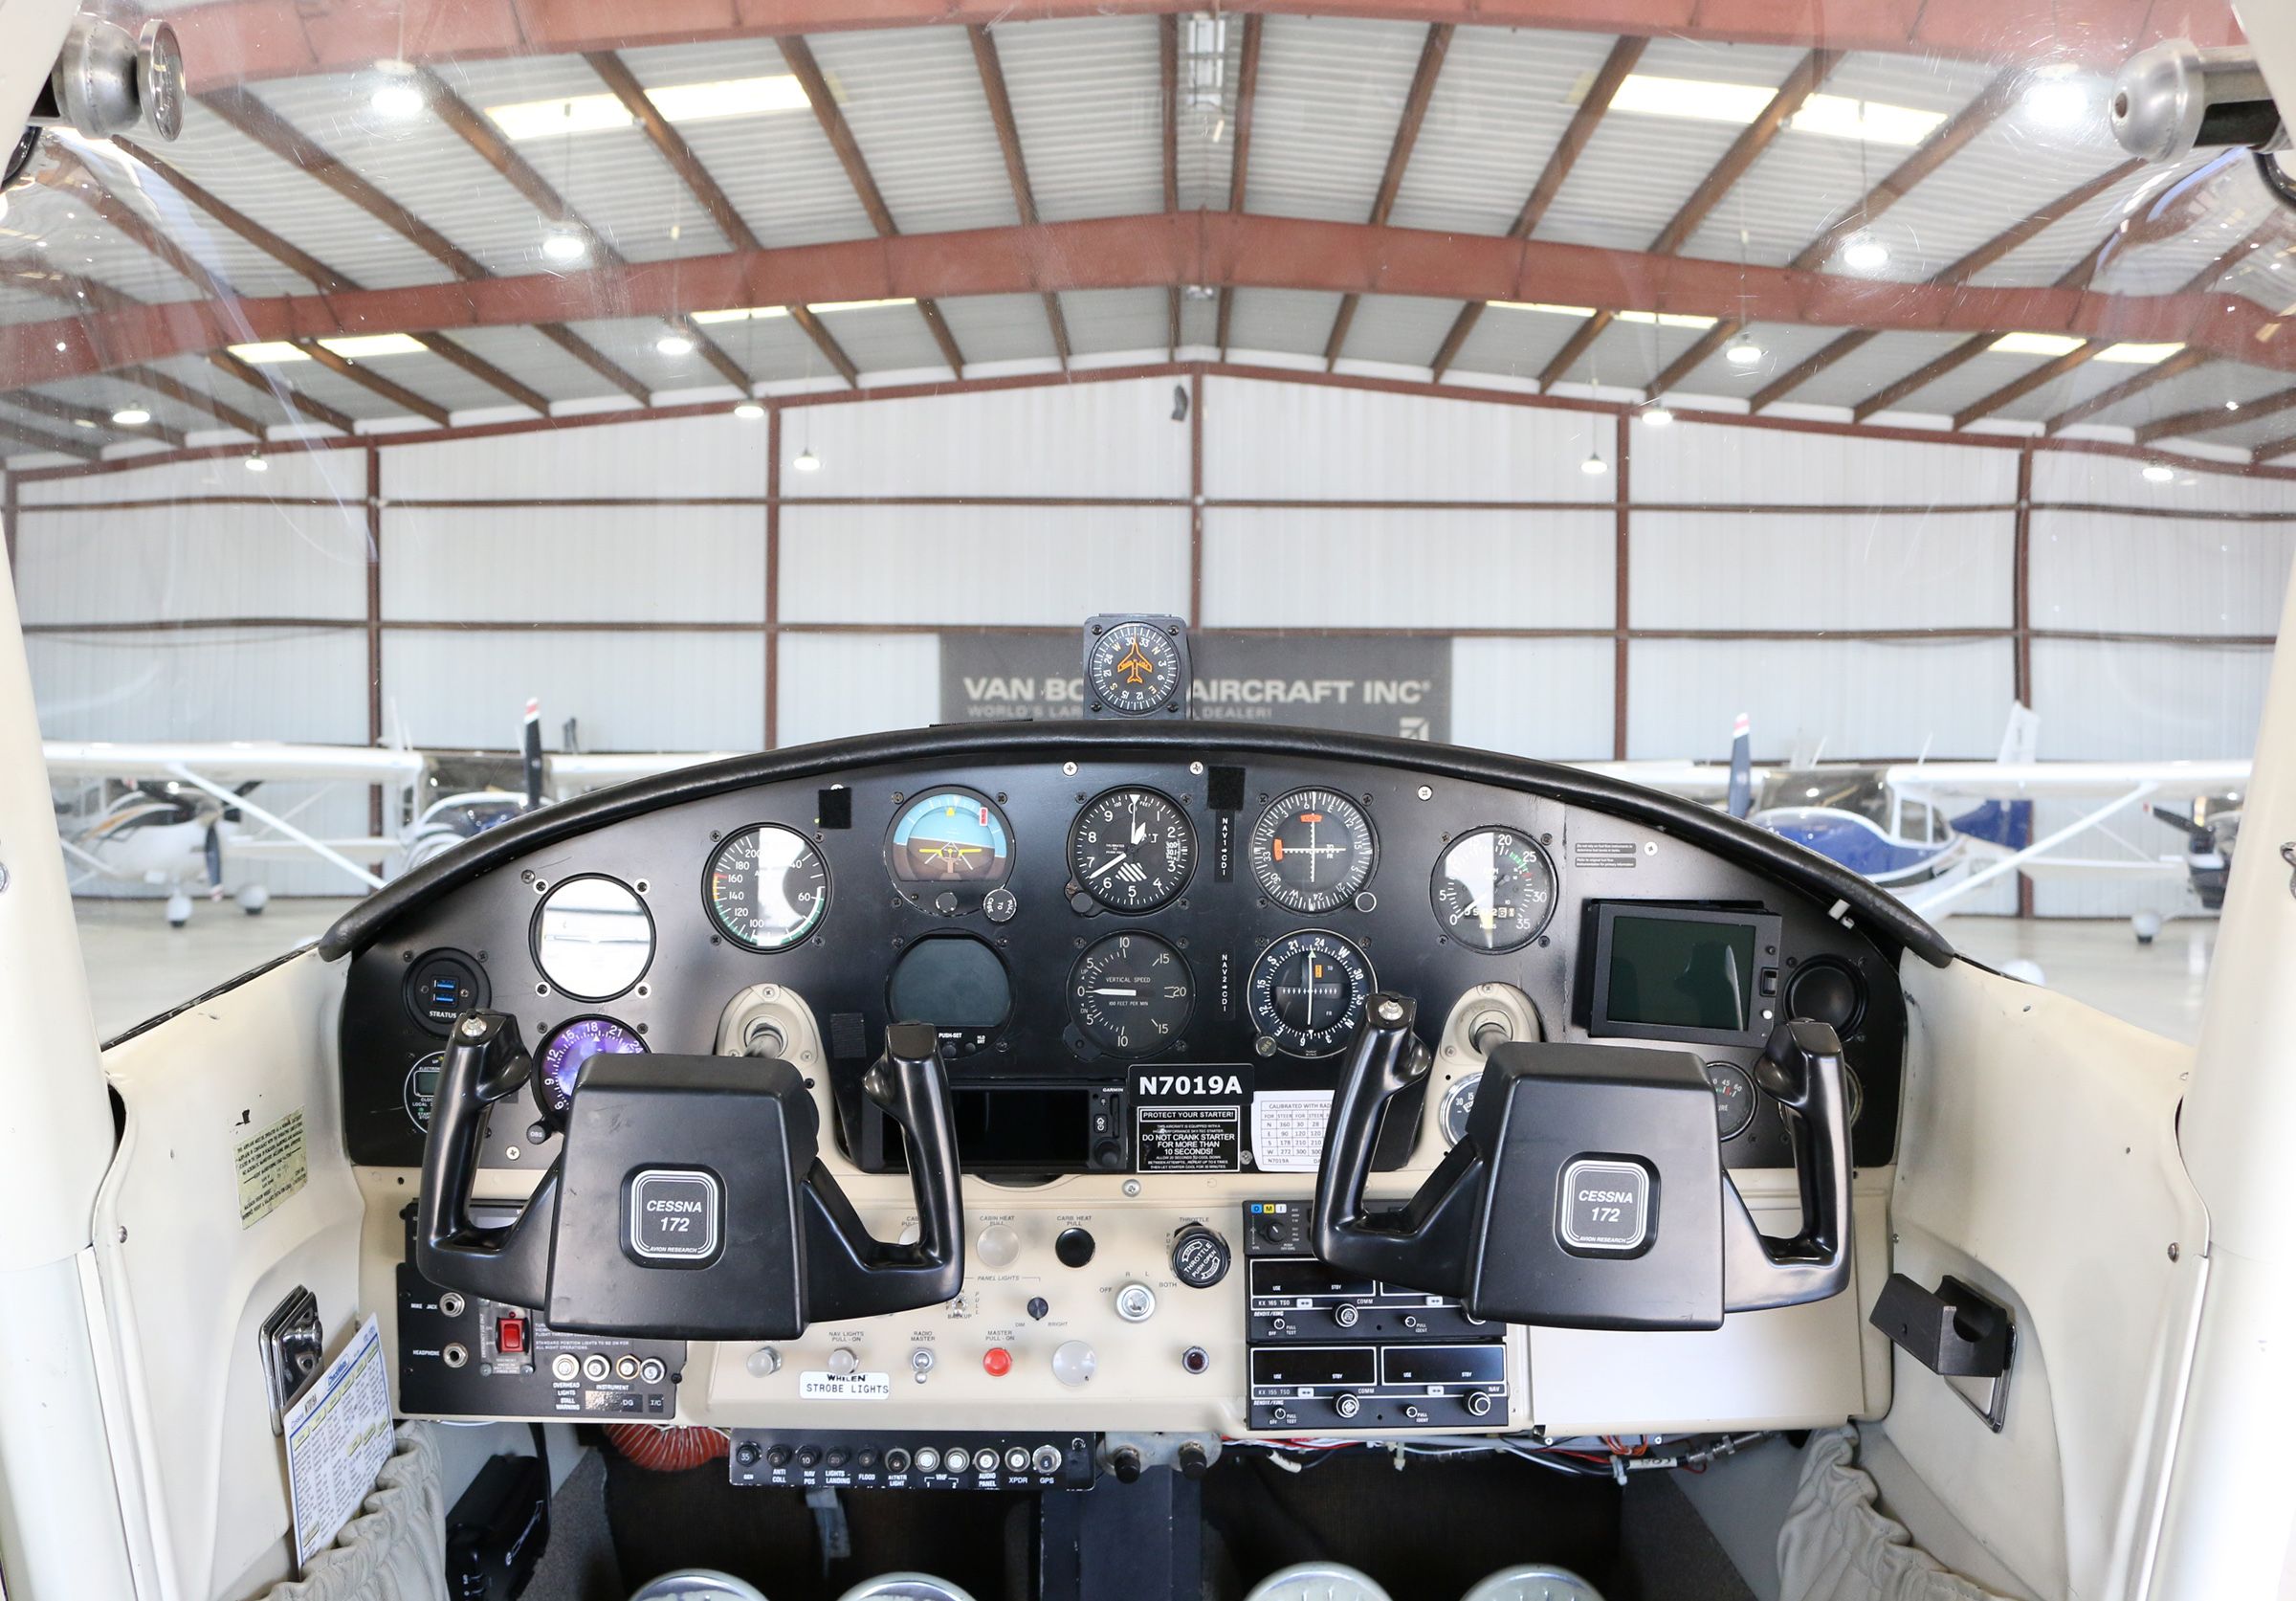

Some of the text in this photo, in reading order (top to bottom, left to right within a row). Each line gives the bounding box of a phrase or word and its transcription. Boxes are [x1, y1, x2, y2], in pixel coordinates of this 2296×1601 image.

[1125, 637, 1135, 646] 30
[1139, 637, 1150, 647] 33
[962, 678, 1034, 701] VAN
[1186, 678, 1355, 703] AIRCRAFT
[1104, 811, 1113, 822] 9
[1088, 832, 1096, 843] 8
[1167, 826, 1176, 838] 2
[1498, 834, 1512, 846] 20
[1087, 856, 1094, 868] 7
[1523, 852, 1537, 863] 25
[736, 861, 749, 870] 180
[1167, 861, 1176, 872] 3
[1103, 878, 1112, 888] 6
[1153, 878, 1161, 888] 4
[1128, 886, 1137, 897] 5
[1439, 890, 1446, 901] 5
[1533, 891, 1547, 902] 30
[1516, 919, 1531, 929] 35
[1119, 937, 1130, 947] 10
[1289, 940, 1299, 950] 21
[1314, 938, 1325, 946] 24
[1338, 945, 1350, 958] W
[1087, 958, 1093, 968] 5
[1159, 954, 1169, 964] 15
[1354, 968, 1364, 980] 30
[1257, 979, 1266, 989] 15
[1078, 986, 1084, 996] 0
[1173, 987, 1186, 996] 20
[430, 1011, 456, 1019] STRATUS
[1259, 1006, 1269, 1016] 12
[1087, 1014, 1093, 1025] 5
[585, 1022, 598, 1032] 18
[609, 1025, 622, 1037] 21
[1159, 1024, 1168, 1034] 15
[562, 1030, 574, 1042] 15
[1117, 1035, 1128, 1046] 10
[629, 1040, 643, 1053] 24
[547, 1050, 559, 1061] 12
[1139, 1076, 1243, 1095] N7019A
[1578, 1190, 1632, 1203] CESSNA
[647, 1200, 701, 1212] CESSNA
[1592, 1207, 1620, 1222] 172
[661, 1217, 690, 1232] 172
[1184, 1242, 1212, 1273] THROTTLE
[1192, 1263, 1205, 1278] PUSH
[1203, 1250, 1217, 1264] OPEN
[806, 1384, 888, 1393] STROBE LIGHTS
